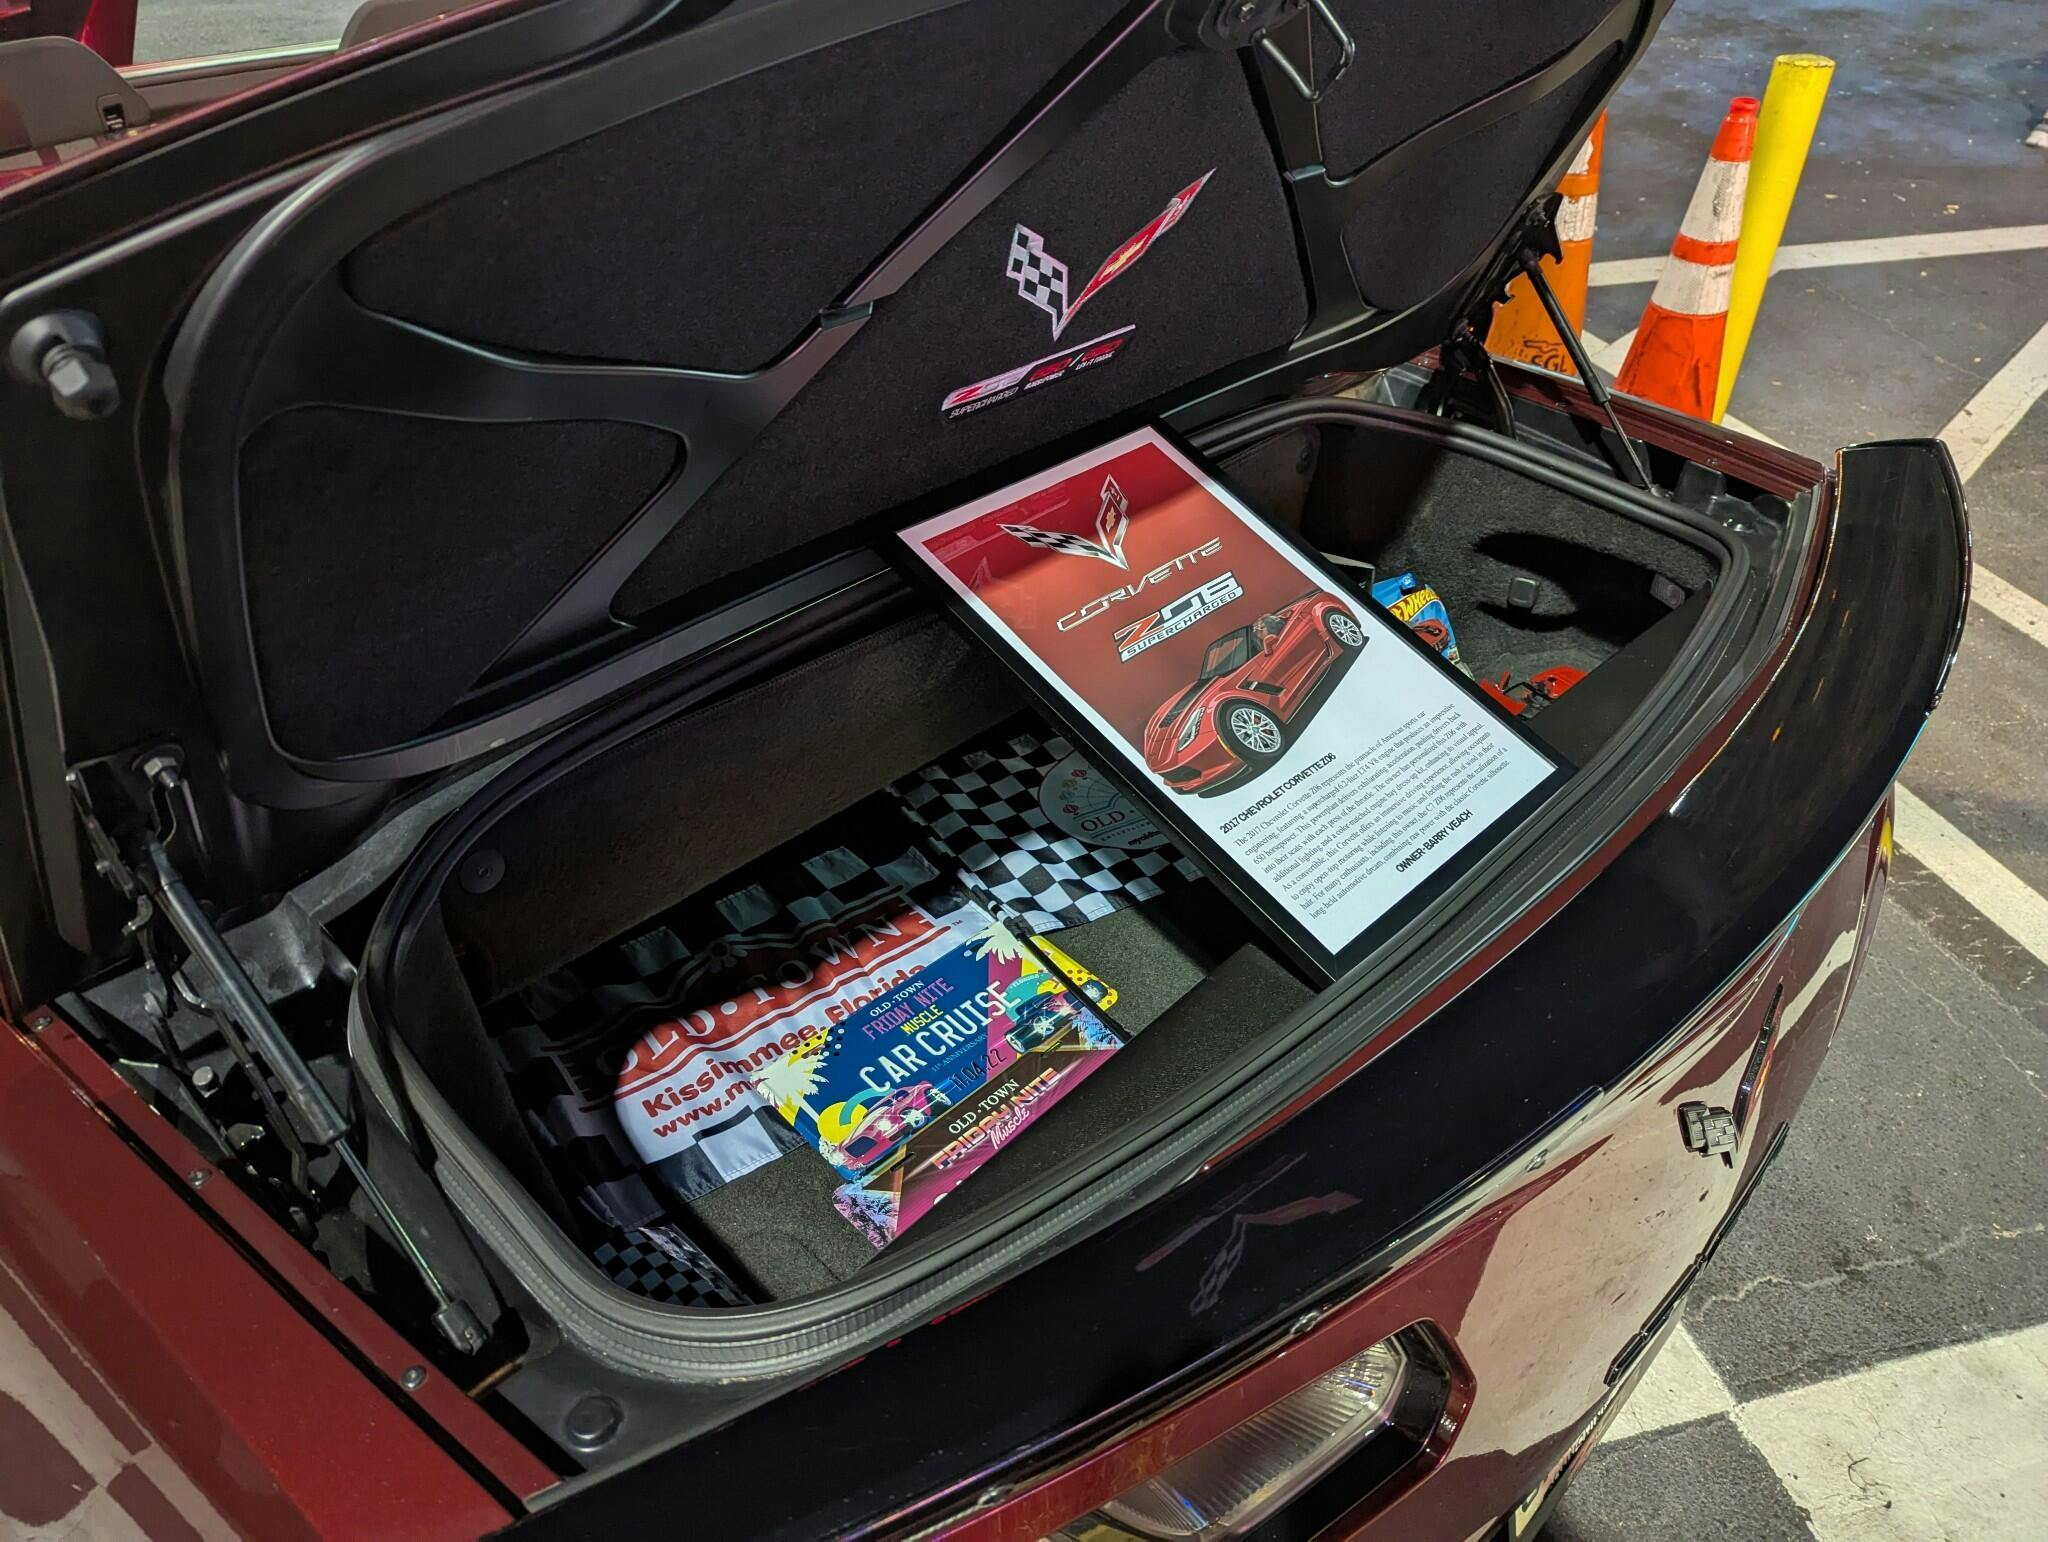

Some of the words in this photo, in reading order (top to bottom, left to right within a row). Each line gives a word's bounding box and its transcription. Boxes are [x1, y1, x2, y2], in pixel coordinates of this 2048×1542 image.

[1056, 536, 1223, 632] CORVETTE
[1113, 571, 1239, 652] Z06
[1126, 591, 1237, 656] SUPERCHARGED
[1081, 811, 1125, 831] OLD
[1219, 816, 1240, 834] 2017
[1237, 785, 1285, 821] CHEVROLET
[1282, 760, 1324, 790] CORVETTE
[1318, 752, 1336, 766] Z06
[1444, 808, 1473, 831] VEACH
[861, 1003, 916, 1040] FRIDAY
[914, 977, 955, 1009] NITE
[869, 1001, 892, 1017] OLD
[894, 980, 926, 1002] TOWN
[900, 1004, 944, 1036] MUSCLE
[858, 1043, 928, 1093] CAR
[915, 980, 1022, 1056] CRUISE
[941, 1034, 988, 1066] ANNIVERSARY
[950, 1048, 1007, 1092] 11.04.22
[930, 1103, 1012, 1170] FRIDAY
[1010, 1067, 1062, 1109] NITE
[948, 1111, 977, 1134] OLD
[978, 1078, 1021, 1111] TOWN
[989, 1106, 1031, 1150] Muscle
